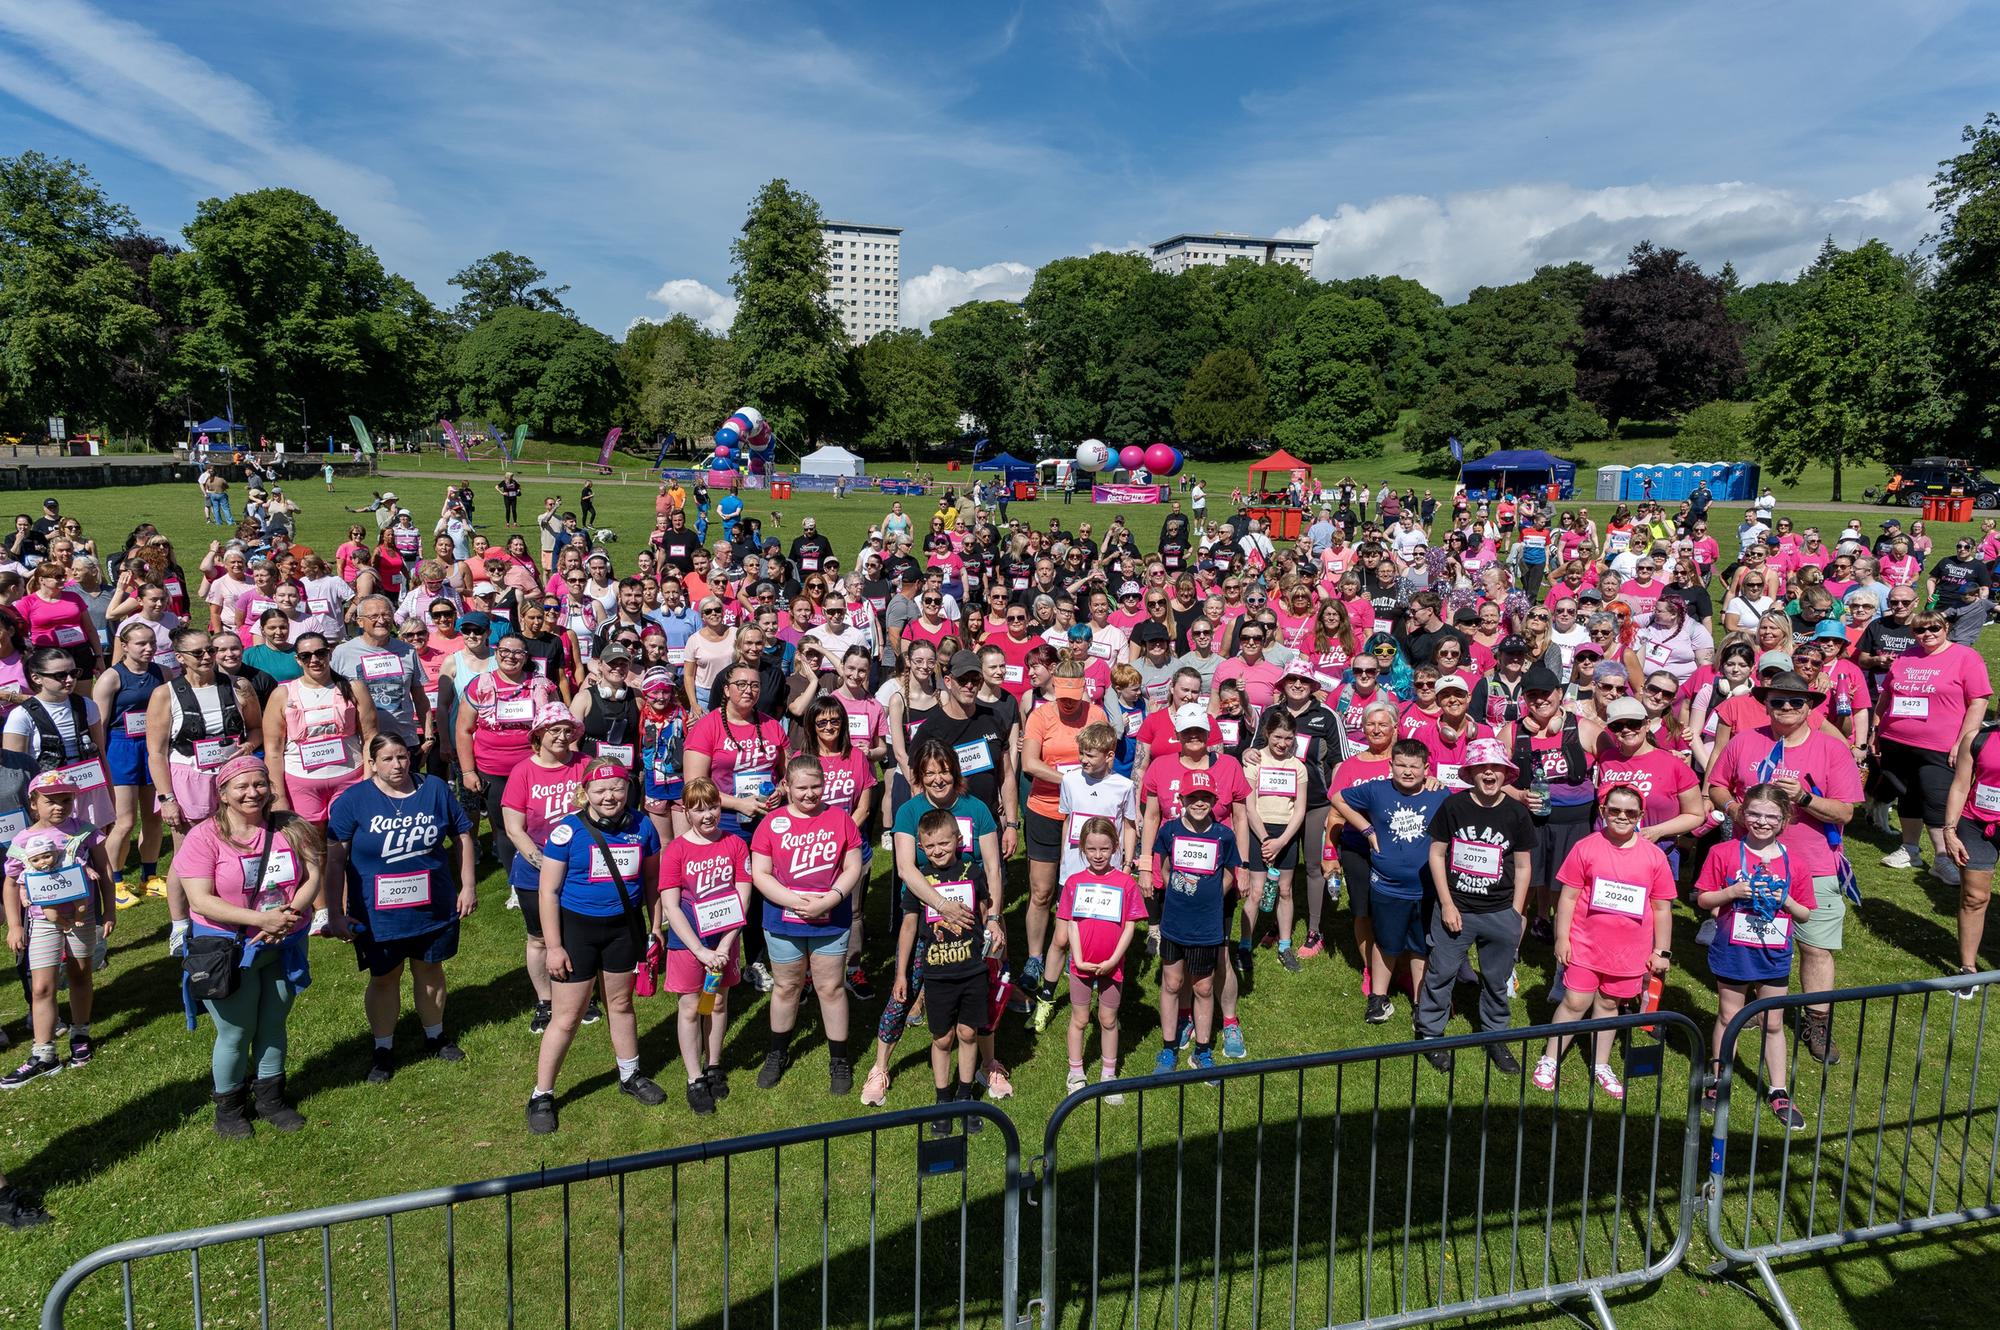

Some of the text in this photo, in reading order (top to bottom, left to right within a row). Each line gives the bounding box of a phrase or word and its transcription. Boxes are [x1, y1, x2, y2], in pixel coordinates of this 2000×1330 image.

[1880, 634, 1915, 645] Slimming
[1885, 640, 1907, 649] World
[1904, 666, 1941, 676] Slimming
[1908, 673, 1930, 681] World
[1894, 682, 1937, 694] Race for Life
[312, 748, 335, 758] 20299
[961, 753, 981, 763] 40046
[1542, 760, 1568, 777] fe
[837, 769, 852, 780] for
[1632, 770, 1653, 781] for
[532, 782, 563, 799] Race
[1985, 795, 2000, 803] 201
[545, 792, 576, 819] Lif
[370, 812, 435, 833] Race for
[1399, 823, 1420, 833] Muddy
[381, 823, 438, 858] Life
[781, 829, 834, 850] Race for
[790, 841, 837, 873] Life
[1183, 850, 1208, 859] 20394
[1464, 853, 1487, 864] 20179
[603, 858, 629, 867] 2293
[686, 856, 729, 875] Race for
[696, 864, 733, 894] Life
[41, 880, 73, 892] 40039
[390, 886, 417, 895] 20270
[1456, 880, 1488, 895] YOUTH
[1605, 891, 1634, 903] 20240
[709, 907, 731, 919] 20271
[1746, 925, 1776, 935] 20266
[928, 938, 973, 966] GROOT
